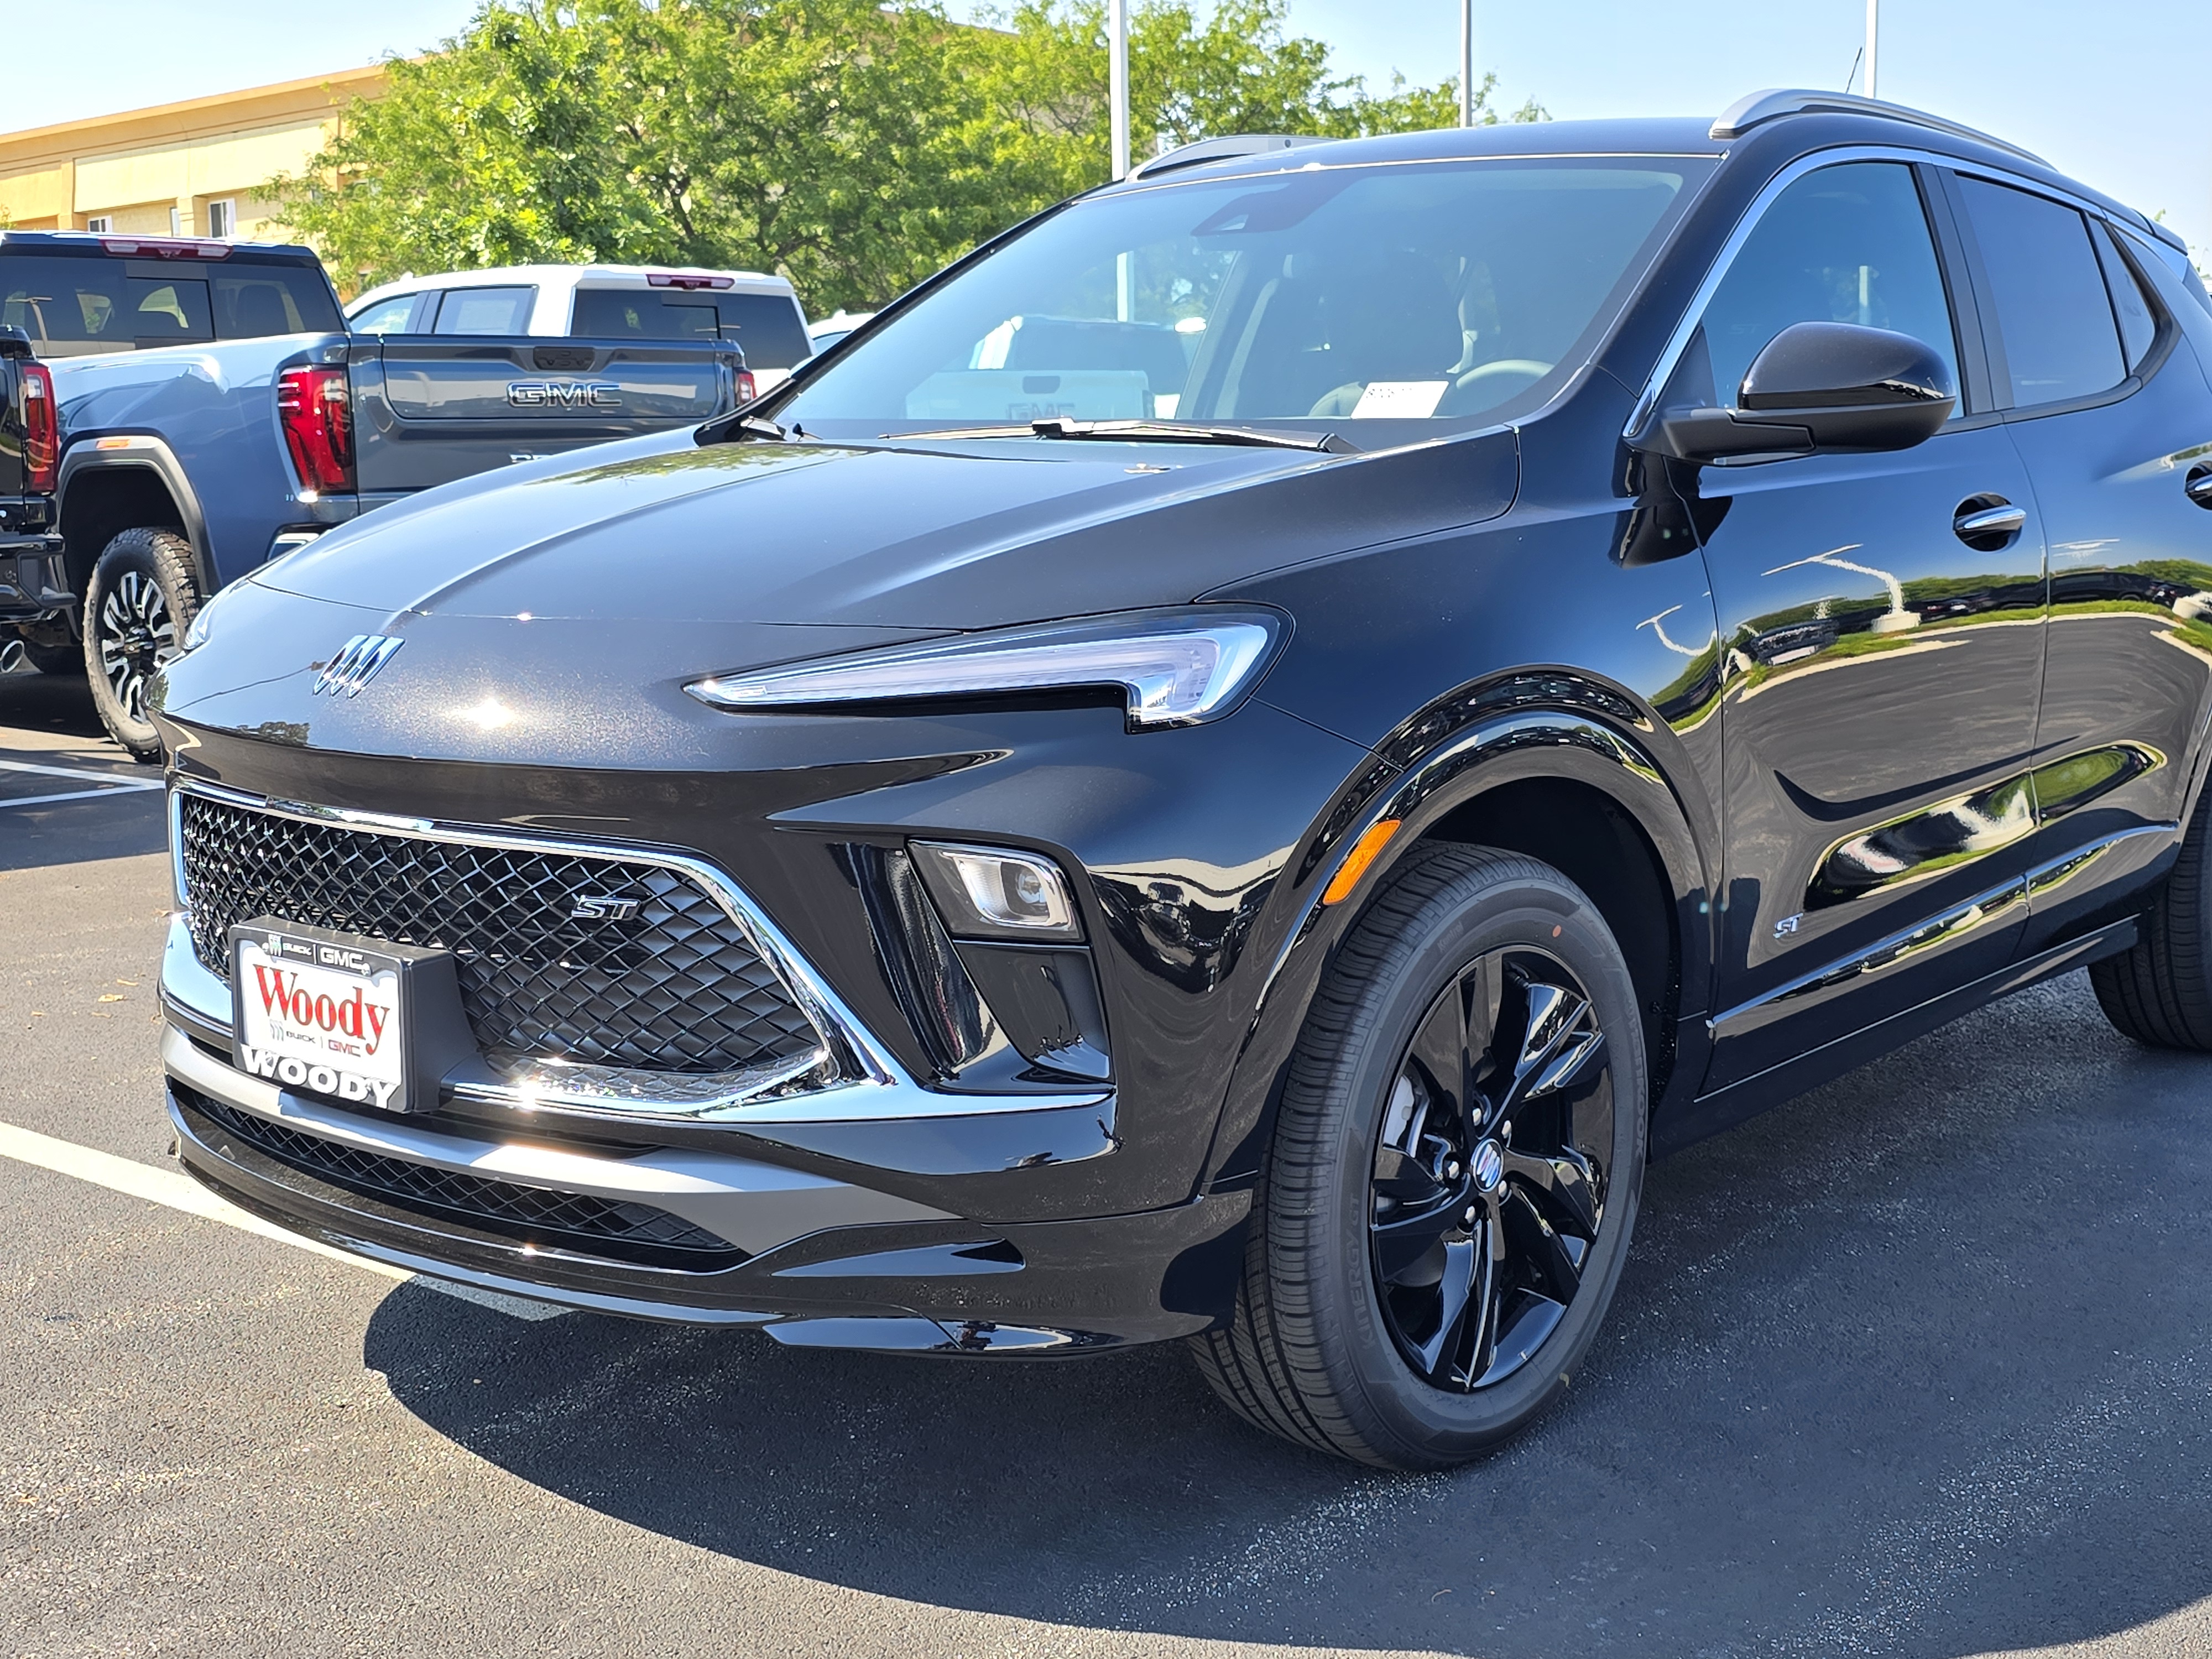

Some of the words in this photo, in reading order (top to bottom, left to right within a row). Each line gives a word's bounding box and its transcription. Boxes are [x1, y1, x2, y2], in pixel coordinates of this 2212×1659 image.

[507, 382, 622, 408] GMC
[571, 895, 640, 920] ST
[1773, 912, 1803, 938] ST
[283, 942, 312, 956] BUICK
[320, 947, 365, 969] GMC
[253, 963, 390, 1055] Woody
[286, 1031, 316, 1044] BUICK
[328, 1039, 361, 1057] GMC
[241, 1045, 398, 1109] WOODY
